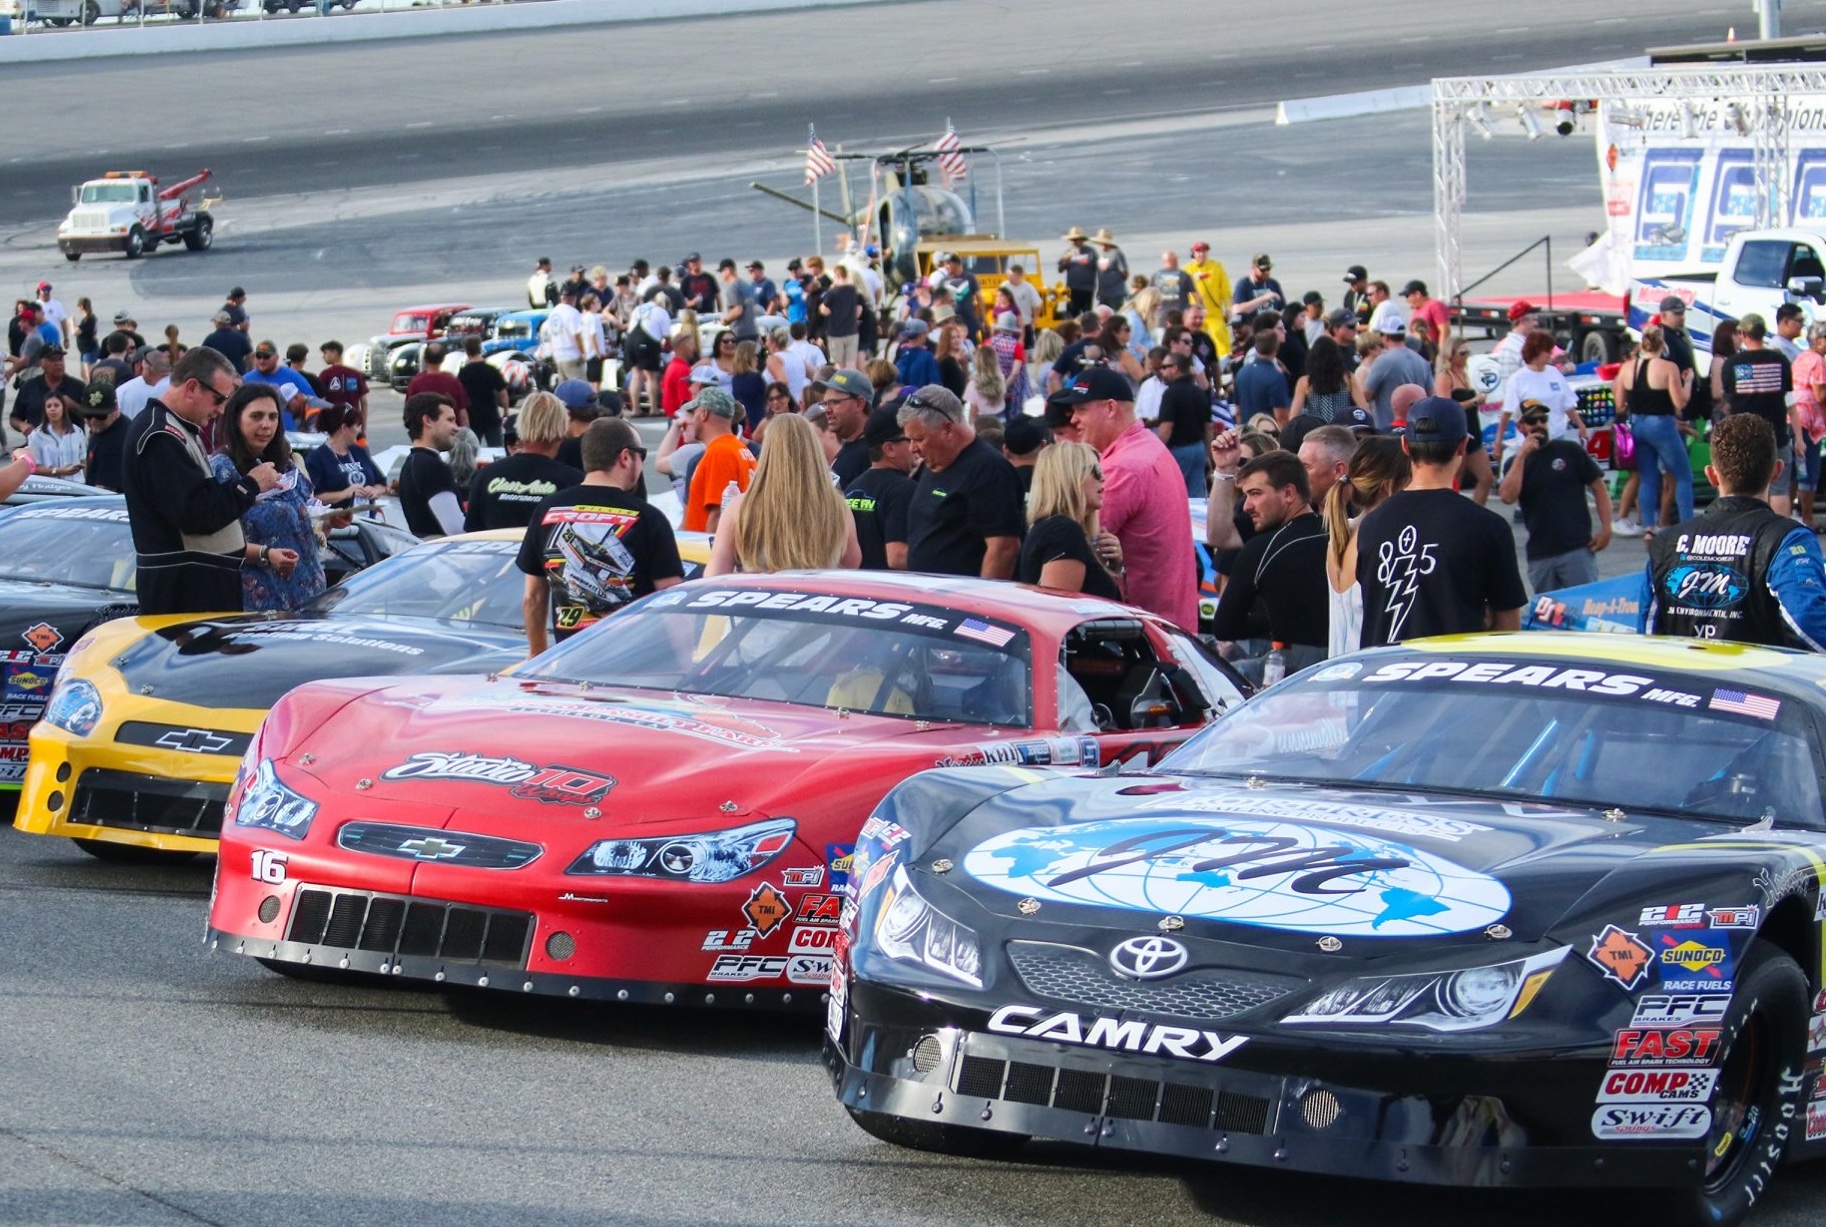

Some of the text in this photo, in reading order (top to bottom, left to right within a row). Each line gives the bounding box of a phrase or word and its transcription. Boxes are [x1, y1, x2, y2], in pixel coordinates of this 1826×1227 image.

[12, 507, 131, 522] SPEAR
[543, 511, 639, 524] CROFT
[1675, 534, 1751, 556] C. MOORE
[560, 607, 582, 626] 29
[687, 591, 949, 630] SPEARS MFG.
[312, 633, 424, 656] Solutions
[10, 675, 47, 685] SUNOCO
[1362, 662, 1702, 709] SPEARS MFG.
[7, 693, 27, 701] RACE
[0, 704, 43, 718] FC
[384, 751, 536, 783] Studio
[524, 767, 614, 796] 10
[250, 849, 288, 885] 16
[758, 905, 775, 914] TMI
[798, 895, 840, 919] FA
[1638, 918, 1701, 926] PERFORMANCE
[1609, 950, 1633, 960] TMI
[1664, 950, 1722, 962] SUNOCO
[713, 956, 784, 973] PFC
[1663, 980, 1732, 990] RACE FUELS
[1636, 995, 1730, 1017] PFC
[988, 1004, 1250, 1061] CAMRY
[1614, 1030, 1720, 1059] FAST
[1605, 1072, 1690, 1095] COMP
[1658, 1089, 1701, 1099] CAMS
